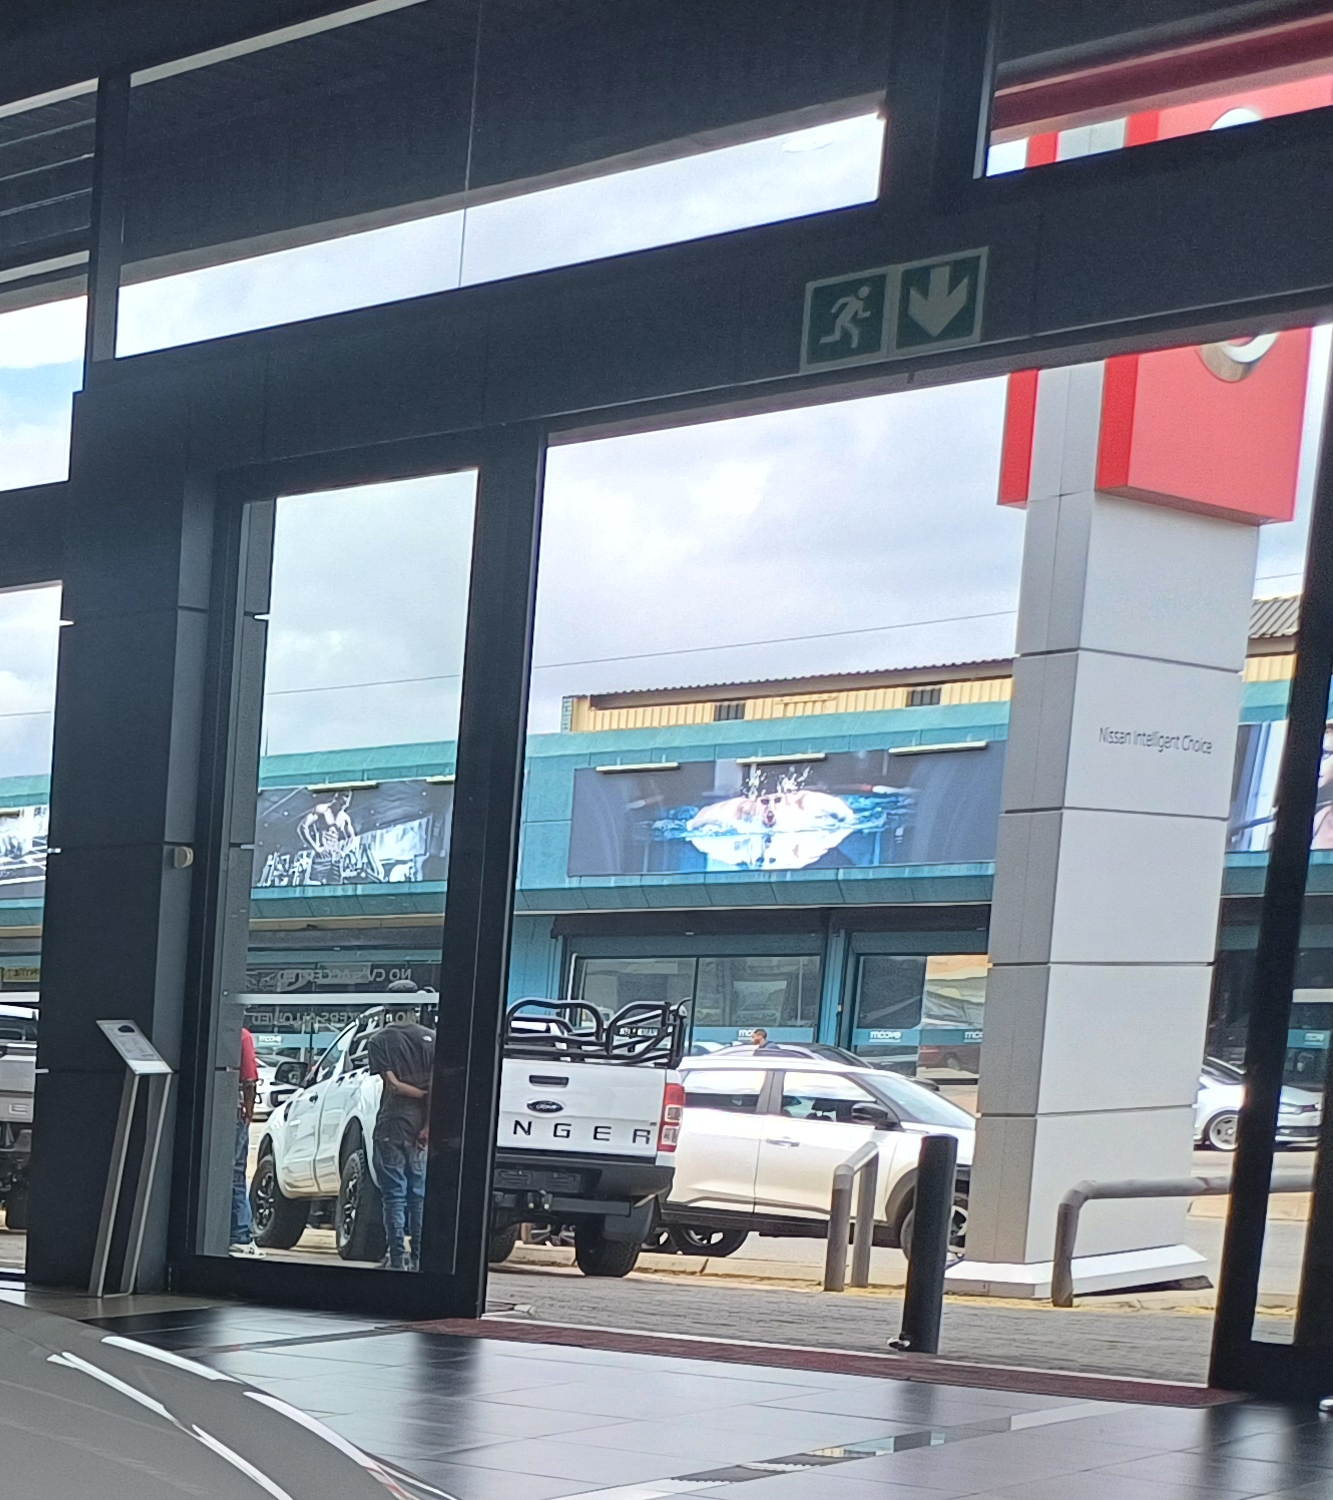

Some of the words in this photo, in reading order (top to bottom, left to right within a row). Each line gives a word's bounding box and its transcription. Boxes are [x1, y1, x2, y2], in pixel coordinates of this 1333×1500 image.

[1098, 727, 1132, 745] Nissan
[1133, 730, 1181, 753] Intelligent
[1181, 734, 1213, 755] Choice
